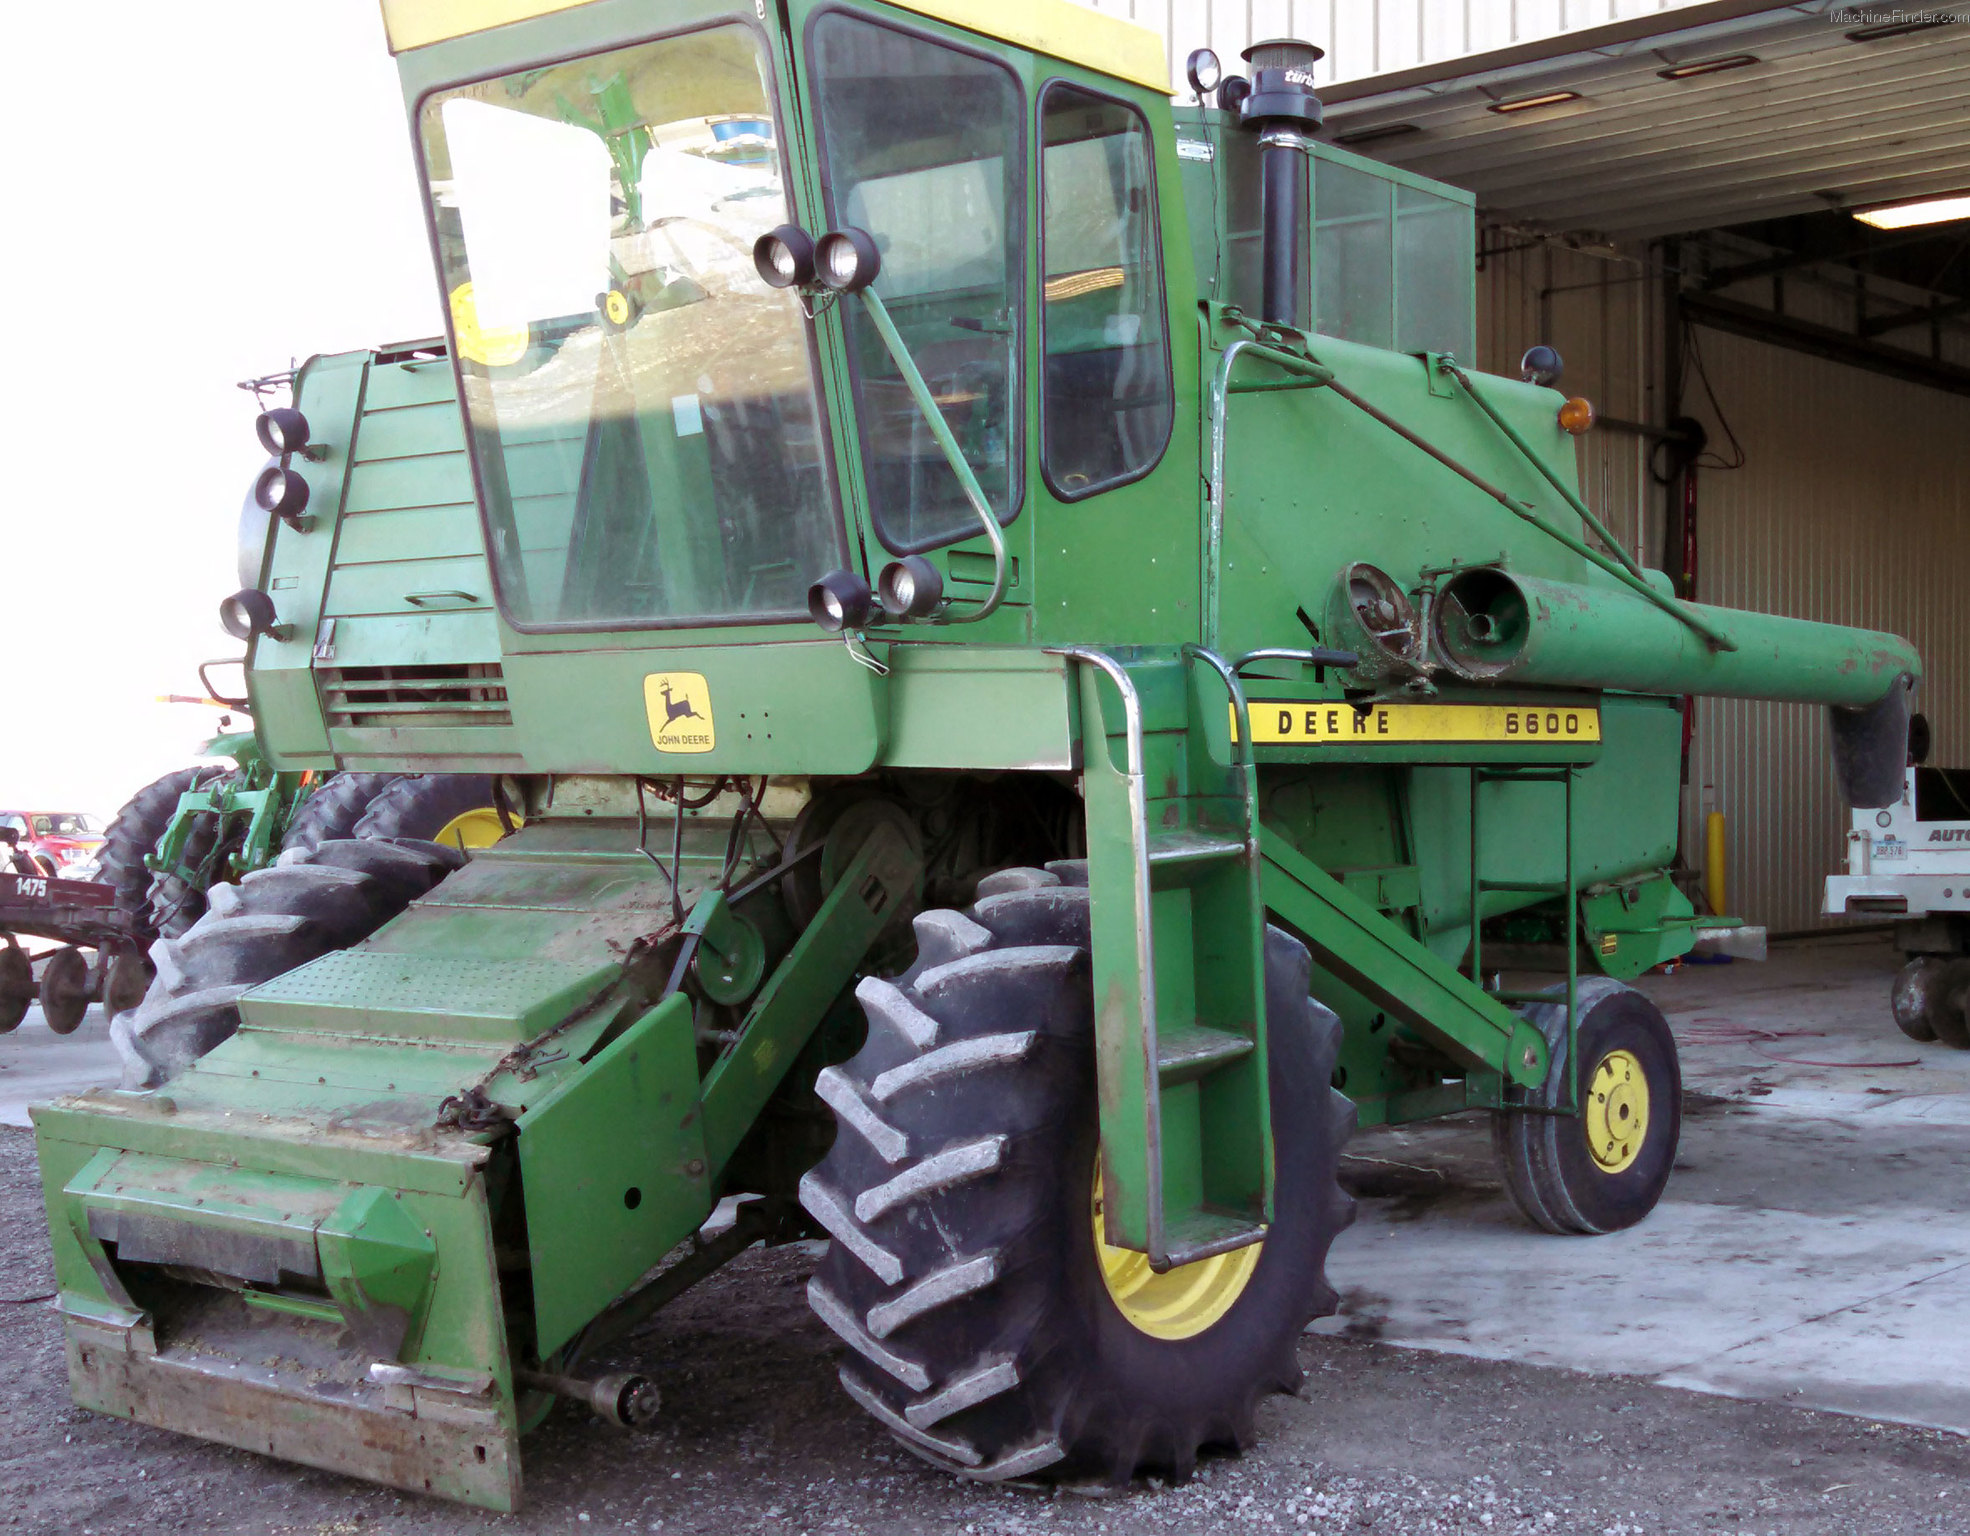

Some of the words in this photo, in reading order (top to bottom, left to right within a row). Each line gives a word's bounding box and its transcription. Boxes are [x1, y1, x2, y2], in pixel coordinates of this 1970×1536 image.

[1278, 711, 1389, 735] DEERE
[1506, 713, 1579, 735] 6600
[657, 735, 680, 745] JOHN
[682, 735, 711, 745] DEERE
[16, 877, 47, 897] 1475
